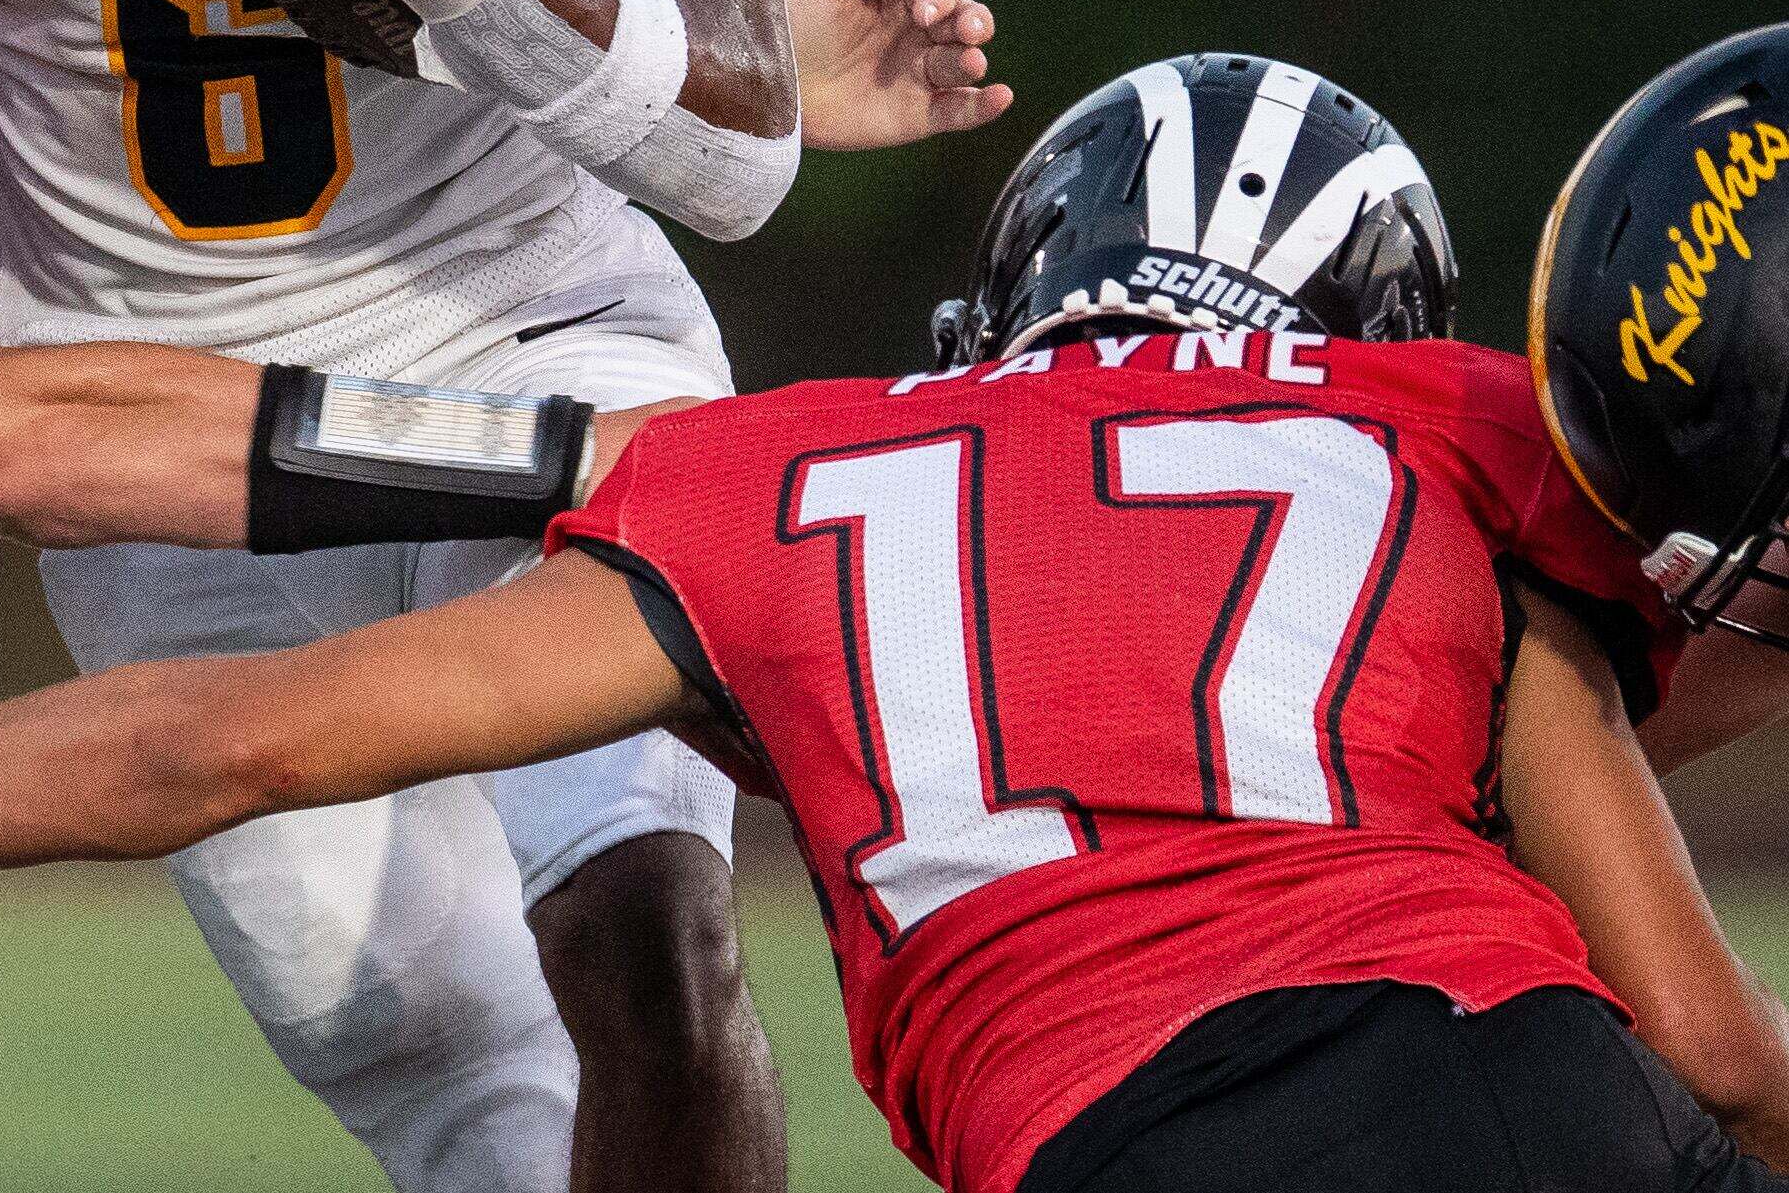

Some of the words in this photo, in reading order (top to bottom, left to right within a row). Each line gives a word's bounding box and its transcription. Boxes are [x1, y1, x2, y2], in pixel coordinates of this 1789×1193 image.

[1130, 255, 1303, 332] schutt
[1618, 120, 1789, 386] Knights
[777, 402, 1412, 956] 17
